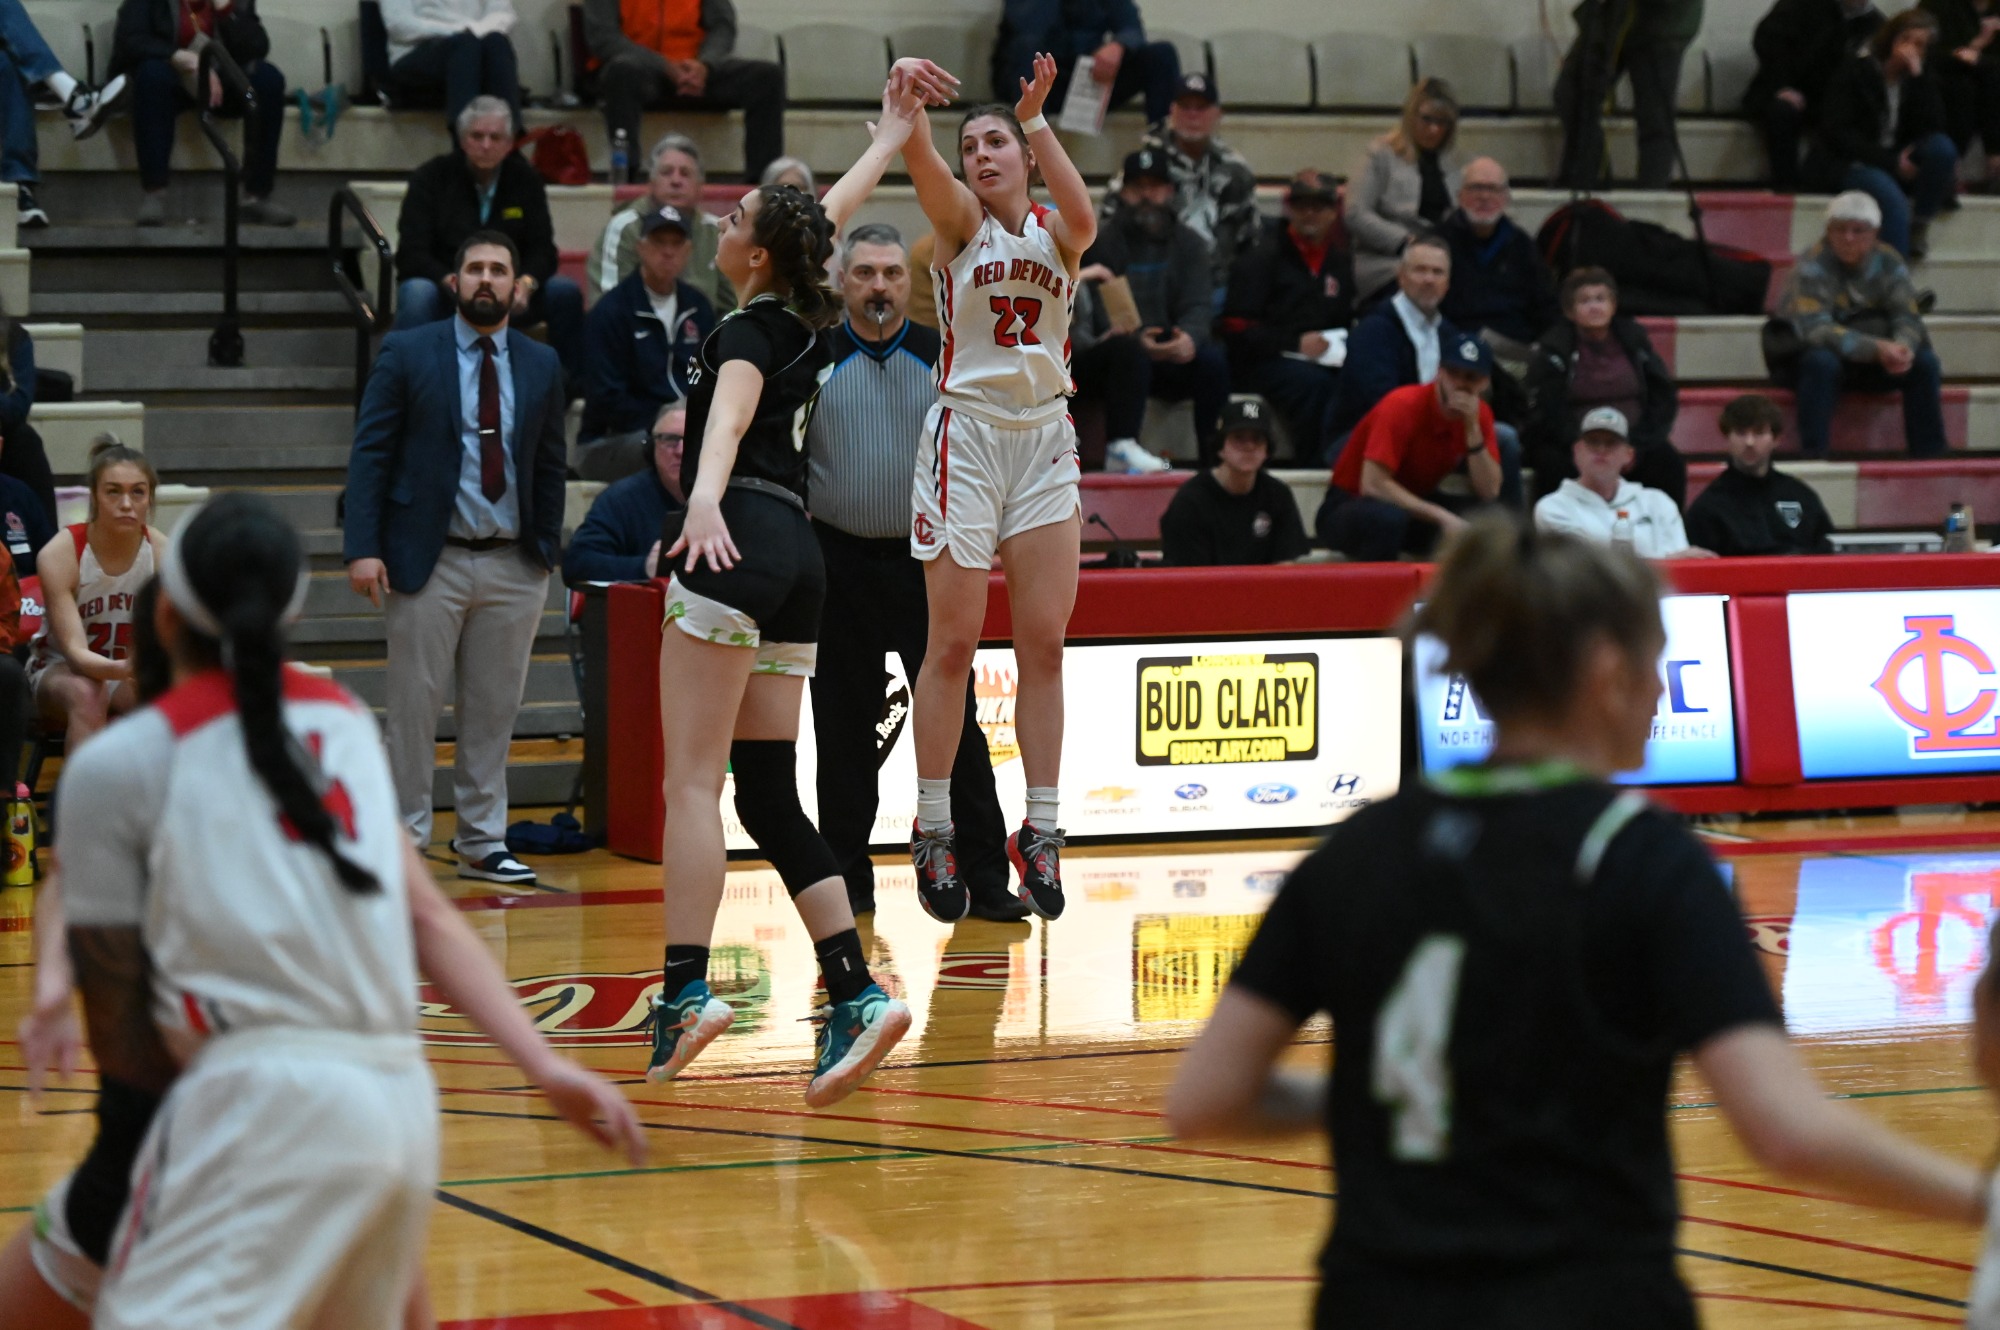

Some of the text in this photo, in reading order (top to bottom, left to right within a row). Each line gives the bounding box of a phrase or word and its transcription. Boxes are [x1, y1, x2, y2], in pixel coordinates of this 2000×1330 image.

[973, 258, 1063, 299] RED DEVILS
[989, 295, 1043, 348] 22
[79, 592, 134, 620] RED DEV
[87, 622, 134, 660] 25
[875, 701, 908, 740] Rock
[1146, 676, 1310, 733] BUD CLARY
[1169, 738, 1288, 765] BUDCLARY.COM
[1440, 724, 1718, 746] NORTH FERENCE
[1252, 783, 1292, 803] Ford
